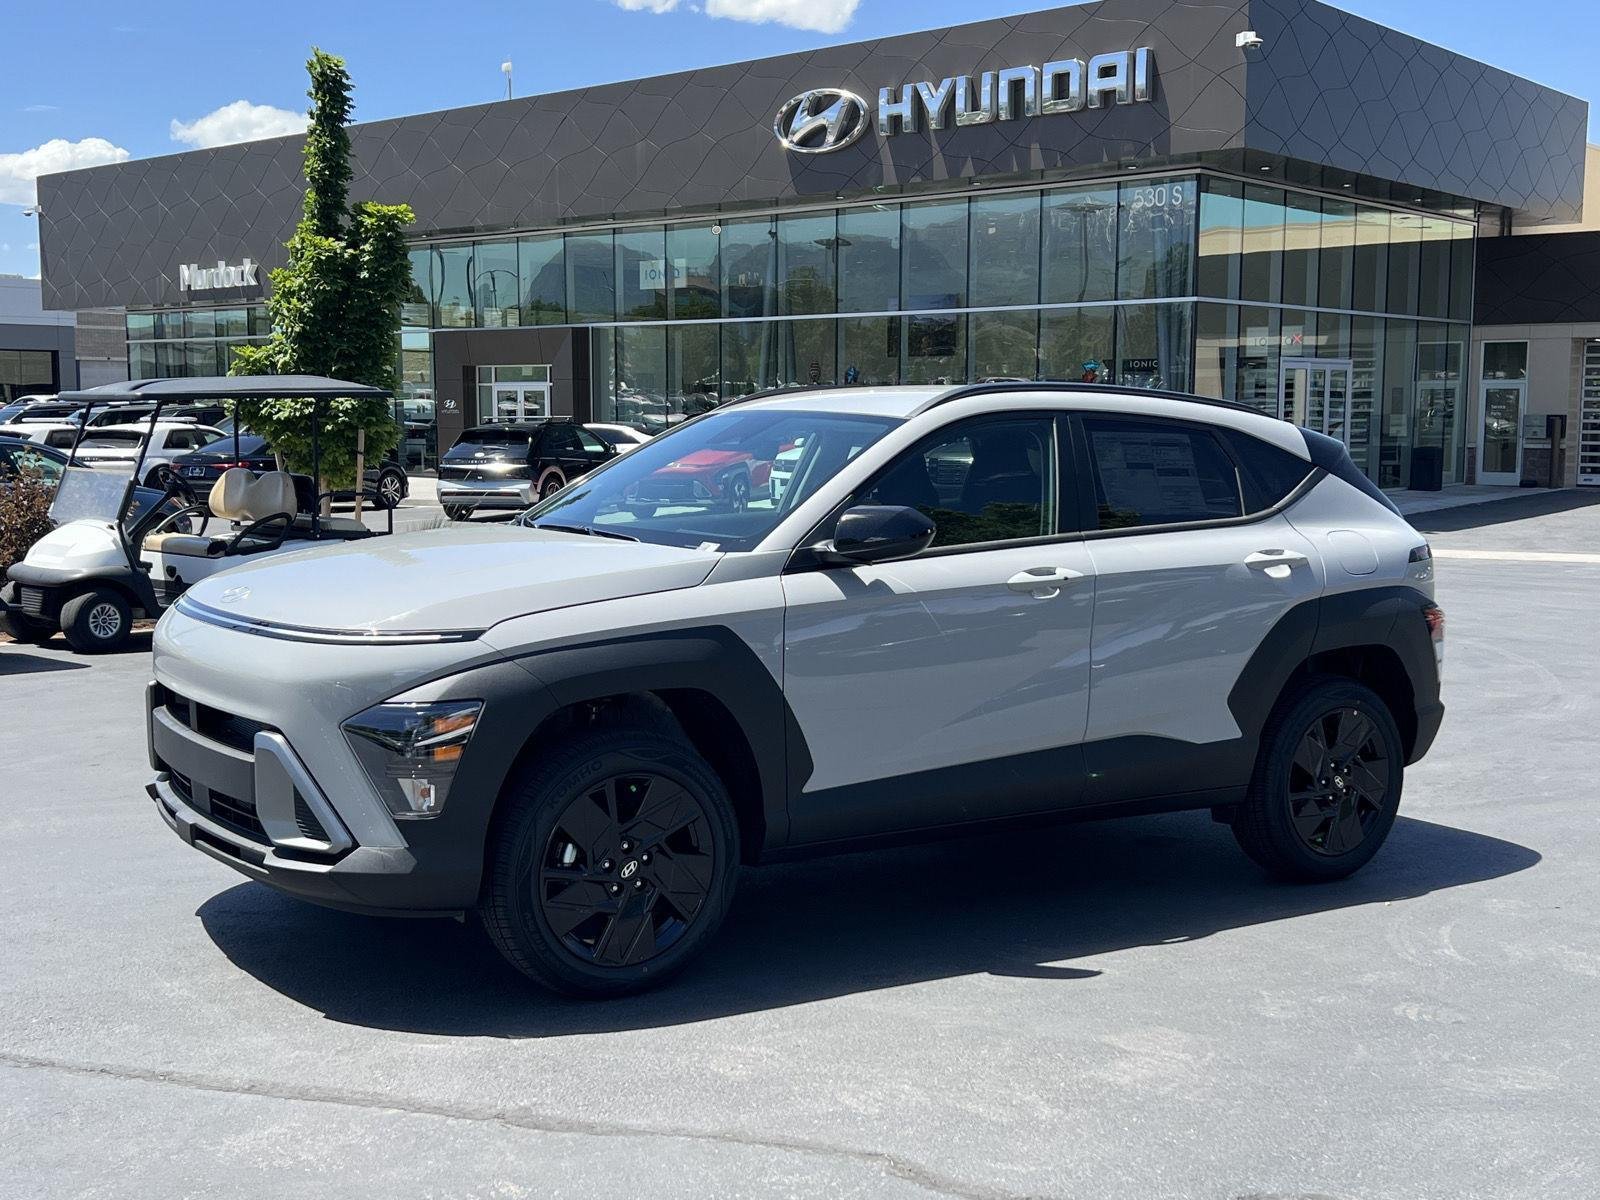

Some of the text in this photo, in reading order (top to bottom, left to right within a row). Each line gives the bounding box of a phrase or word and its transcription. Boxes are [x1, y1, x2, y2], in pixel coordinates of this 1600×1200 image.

[878, 46, 1154, 137] HYUNDAI
[1134, 185, 1183, 208] 530 S
[179, 257, 259, 291] Murdock
